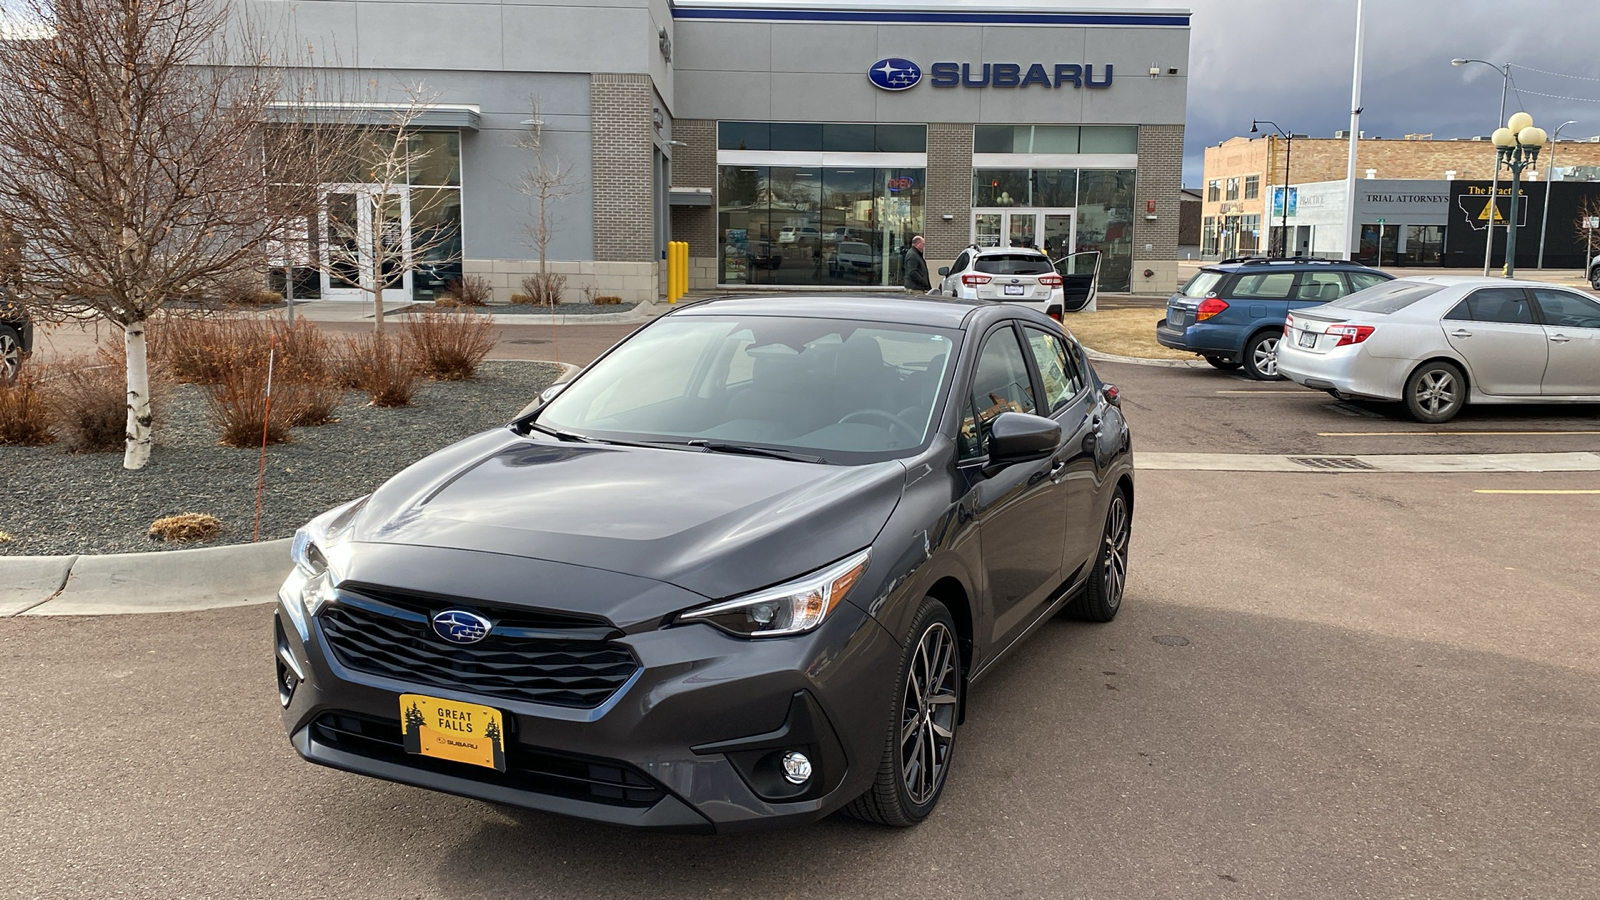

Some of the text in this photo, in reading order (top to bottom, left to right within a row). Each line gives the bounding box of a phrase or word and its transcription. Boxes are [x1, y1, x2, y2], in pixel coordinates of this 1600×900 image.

[930, 62, 1114, 89] SUBARU
[888, 178, 911, 188] OPEN
[1468, 186, 1486, 195] The
[1366, 194, 1449, 203] TRIAL ATTORNEYS
[437, 708, 472, 721] GREAT
[439, 718, 473, 732] FALLS
[447, 739, 478, 750] SUBARU
